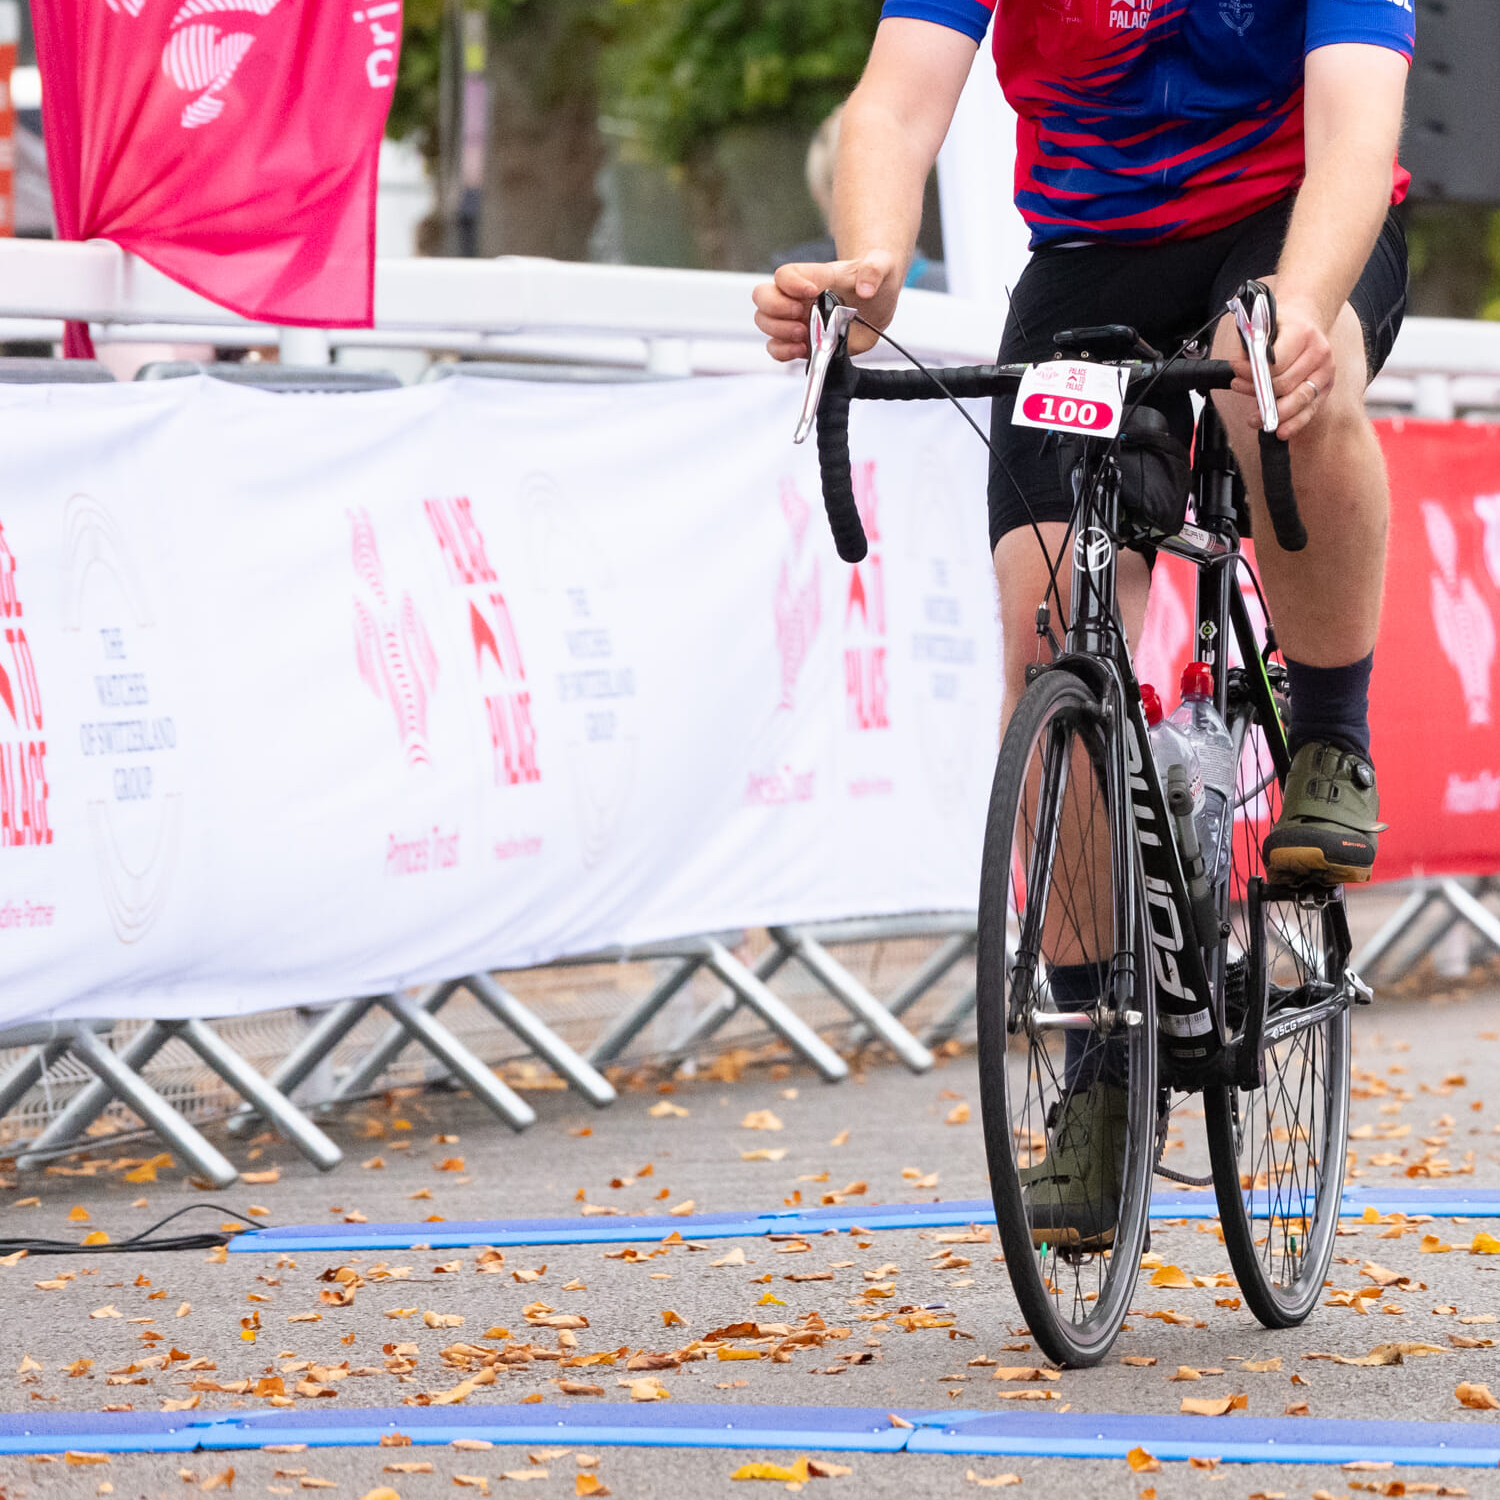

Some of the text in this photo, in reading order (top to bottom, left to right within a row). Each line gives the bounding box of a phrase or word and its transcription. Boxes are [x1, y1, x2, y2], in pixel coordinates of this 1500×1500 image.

[1109, 11, 1150, 30] PALAC
[1039, 397, 1098, 425] 100
[0, 742, 53, 846] ALACE
